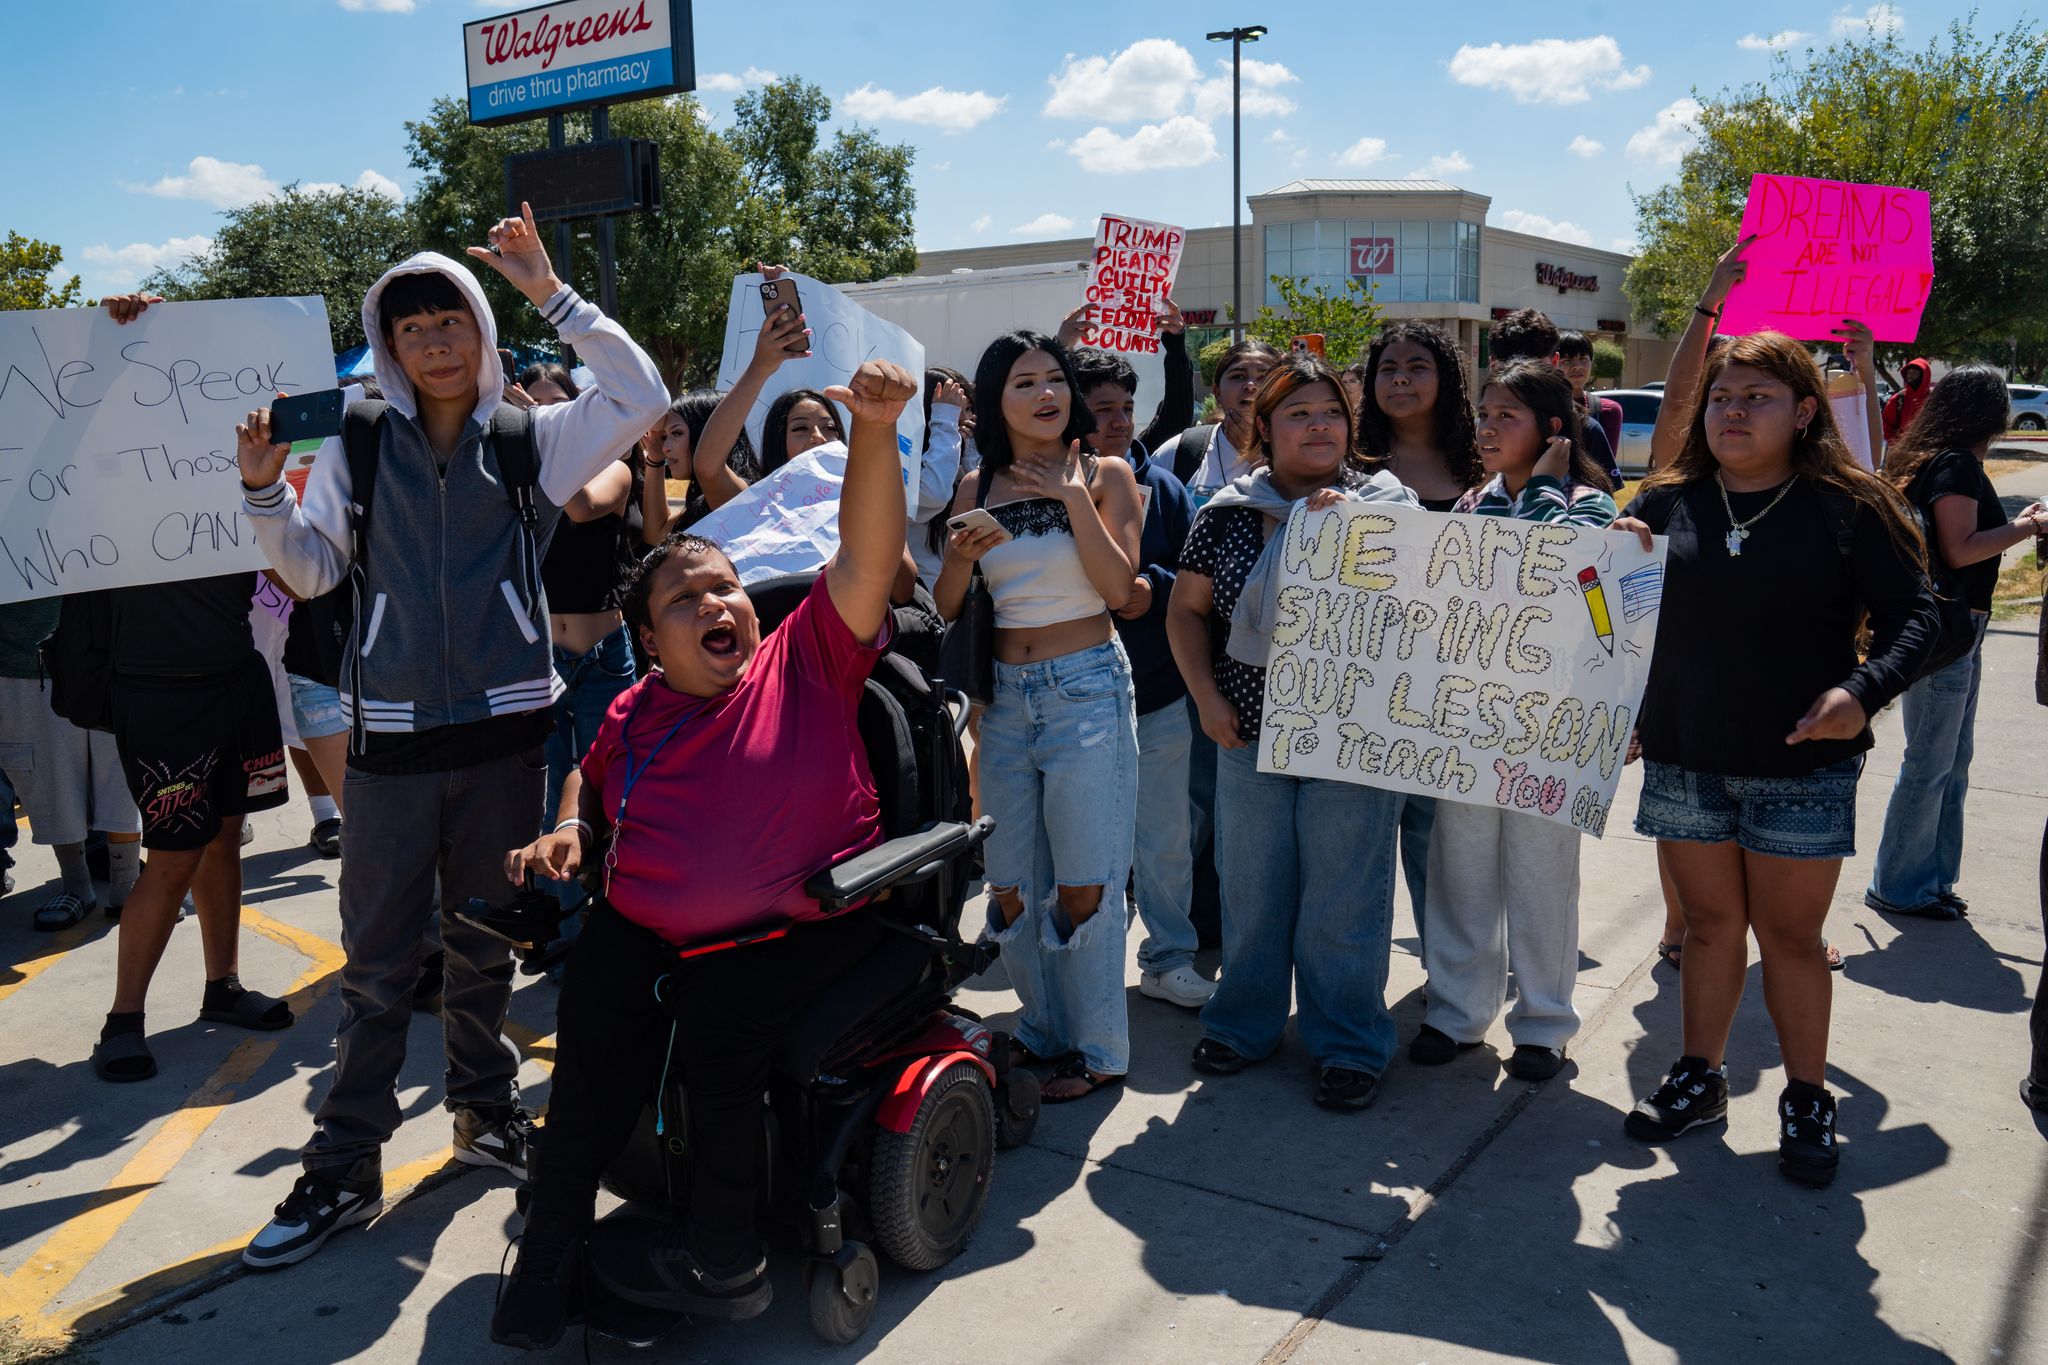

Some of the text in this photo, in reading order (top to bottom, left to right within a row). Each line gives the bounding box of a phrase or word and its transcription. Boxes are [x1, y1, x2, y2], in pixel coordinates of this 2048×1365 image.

[481, 0, 653, 69] Walgreens
[488, 60, 651, 107] drive thru pharmacy
[1757, 178, 1914, 245] DREAMS
[1101, 217, 1180, 255] TRUMP
[1795, 241, 1881, 268] ARE NOT
[1086, 286, 1151, 314] OF 34
[1098, 266, 1171, 299] GUILTY
[1536, 262, 1600, 293] Walgreens
[1768, 269, 1934, 317] ILLEGAL!
[1081, 327, 1160, 353] COUNTS
[1085, 305, 1157, 336] FELONY
[121, 341, 300, 424] Speak
[1286, 507, 1397, 591] WE
[1389, 672, 1631, 780] LESSON
[1494, 758, 1566, 815] YOU
